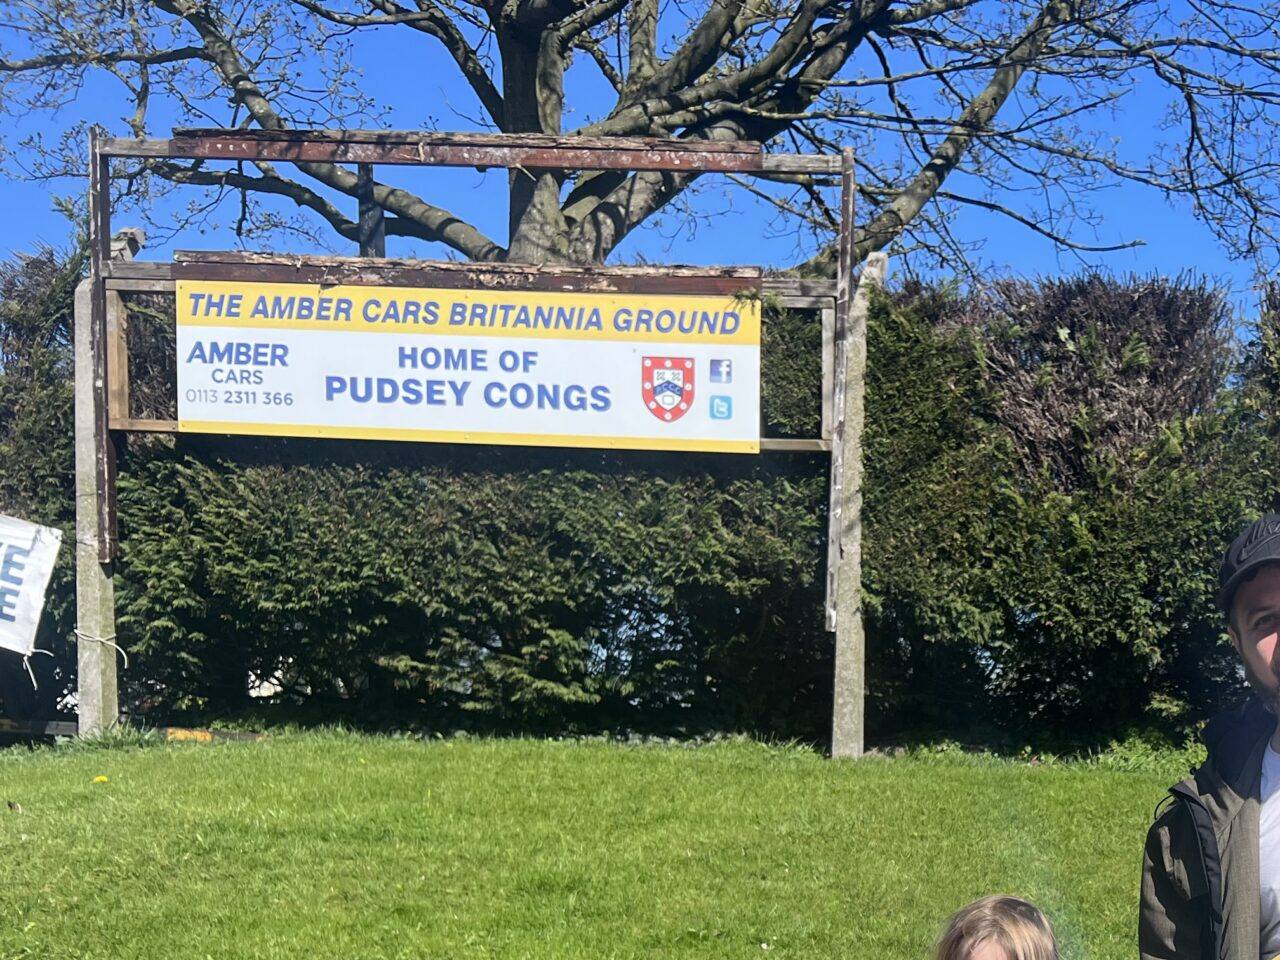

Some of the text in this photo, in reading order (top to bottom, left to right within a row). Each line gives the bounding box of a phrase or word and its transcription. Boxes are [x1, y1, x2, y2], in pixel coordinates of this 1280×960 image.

[189, 293, 741, 335] THE AMBER CARS BRITANNIA GROUND
[186, 341, 289, 367] AMBER
[398, 346, 539, 373] HOME OF
[211, 368, 264, 385] CARS
[185, 388, 293, 406] 0113 2311 366
[325, 376, 612, 412] PUDSEY CONGS
[0, 542, 30, 585] E
